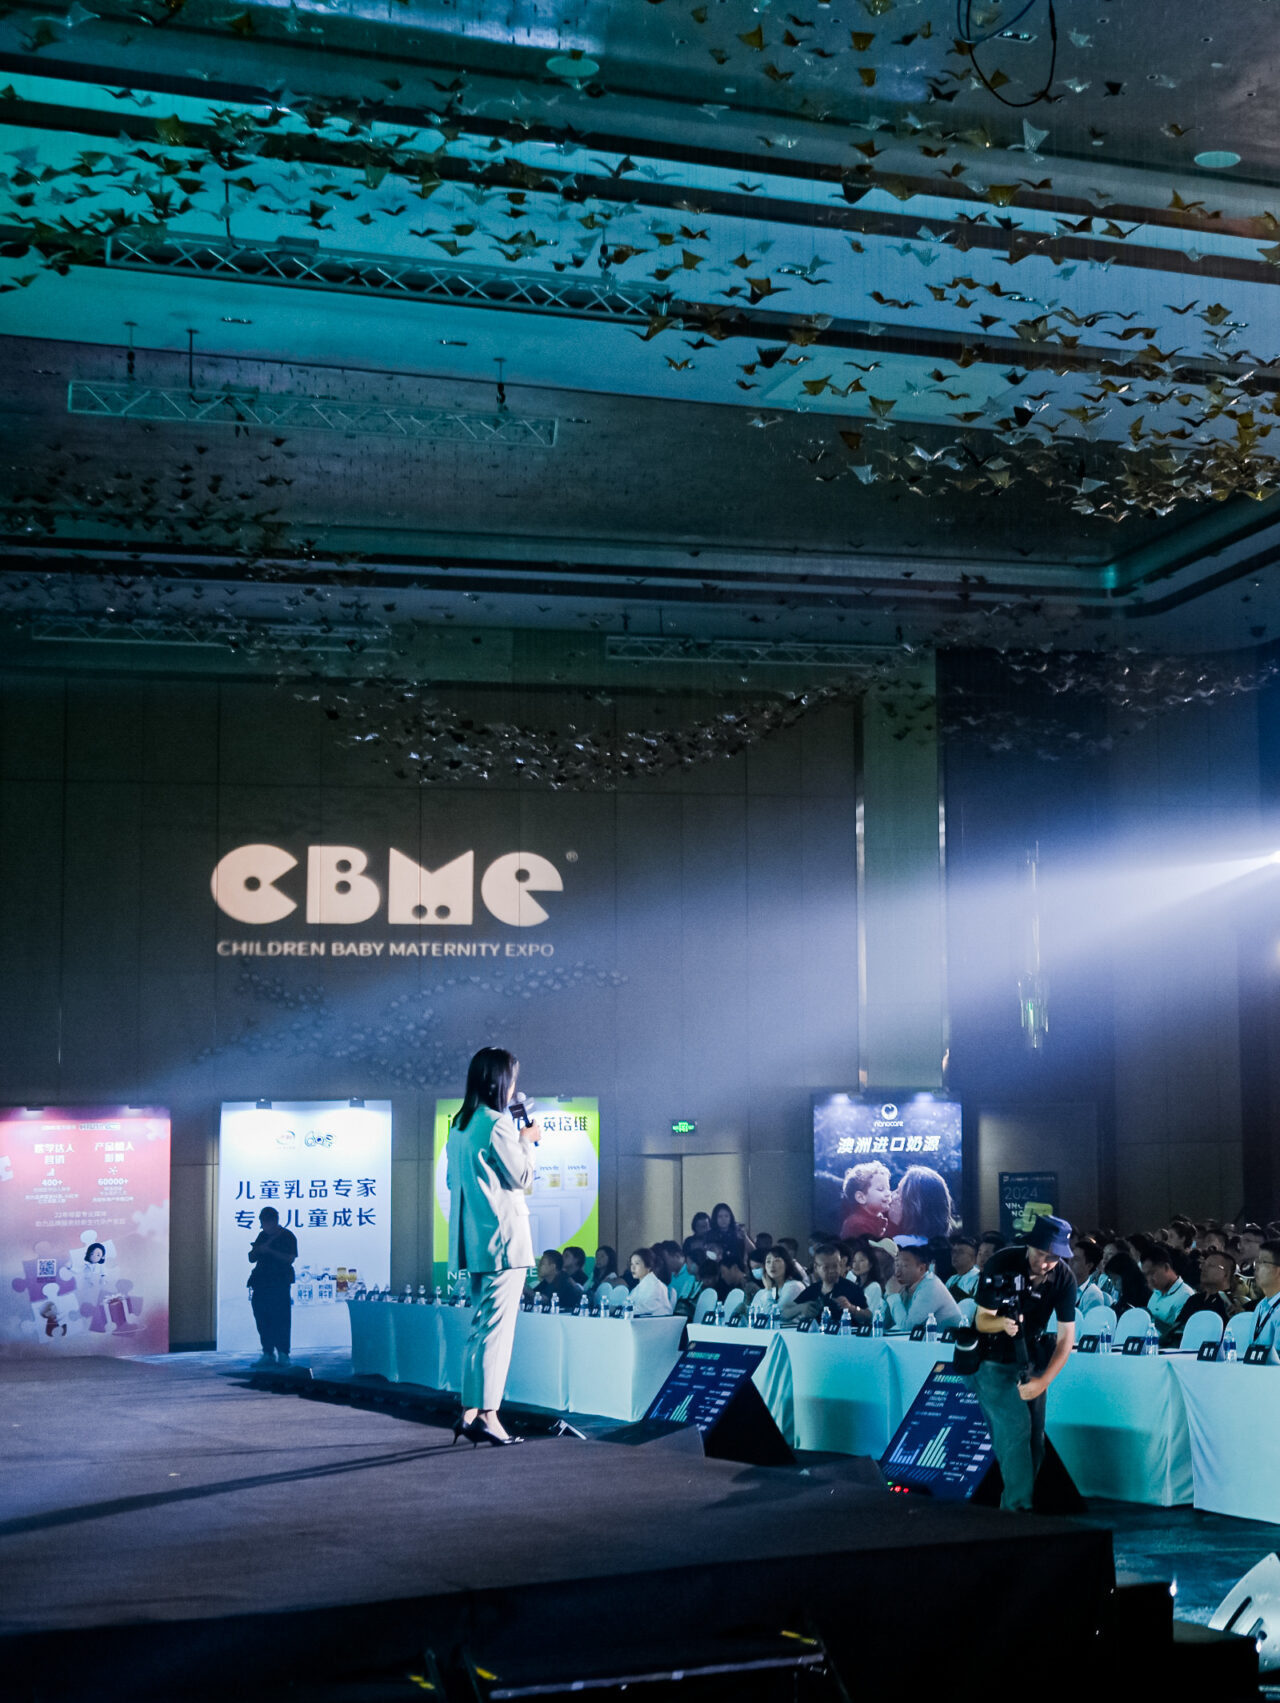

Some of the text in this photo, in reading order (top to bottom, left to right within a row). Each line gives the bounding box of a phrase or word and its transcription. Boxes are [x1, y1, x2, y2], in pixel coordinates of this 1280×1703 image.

[216, 941, 554, 957] CHILDREN BABY MATERNITY EXPO
[837, 1135, 941, 1154] 澳洲进口奶源
[235, 1178, 377, 1200] 儿童乳品专家
[1003, 1186, 1038, 1200] 2024
[234, 1207, 377, 1230] 专儿童成长
